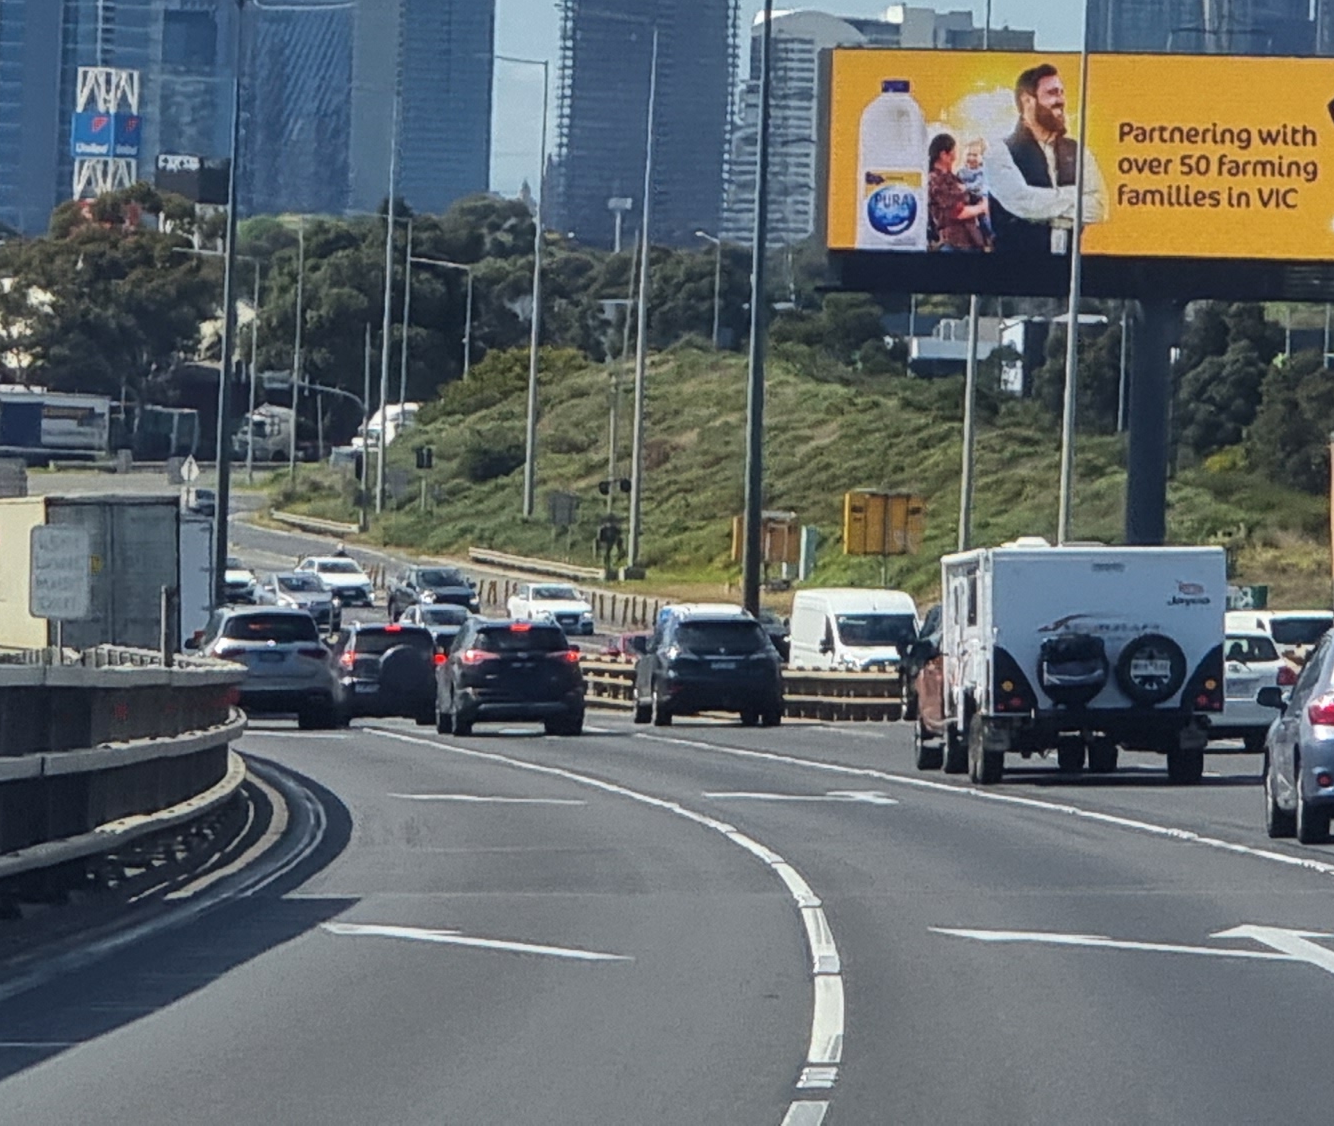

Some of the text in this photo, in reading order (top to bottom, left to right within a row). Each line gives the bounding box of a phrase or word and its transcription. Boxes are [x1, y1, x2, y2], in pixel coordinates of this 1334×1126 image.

[1118, 122, 1317, 151] Partnering with
[1118, 154, 1318, 183] over 50 farming
[875, 193, 910, 208] PURA
[1117, 183, 1299, 209] families in VIC
[1167, 595, 1211, 607] Jayco
